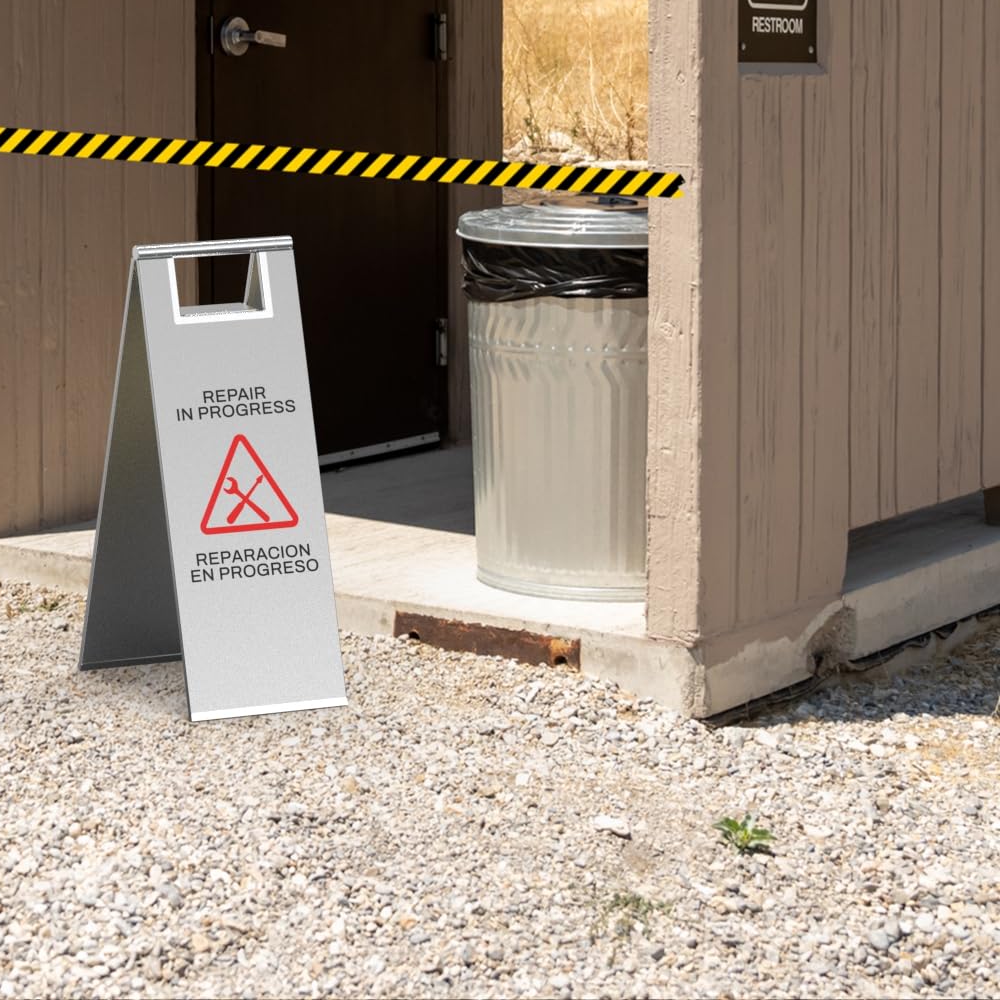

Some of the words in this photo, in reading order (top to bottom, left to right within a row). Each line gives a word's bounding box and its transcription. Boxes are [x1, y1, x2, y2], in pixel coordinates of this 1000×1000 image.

[751, 16, 804, 34] RESTROOM
[203, 386, 266, 403] REPAIR
[176, 408, 194, 422] IN
[198, 399, 296, 420] PROGRESS
[196, 543, 311, 566] REPARACION
[191, 568, 215, 583] EN
[219, 558, 319, 580] PROGRESO
